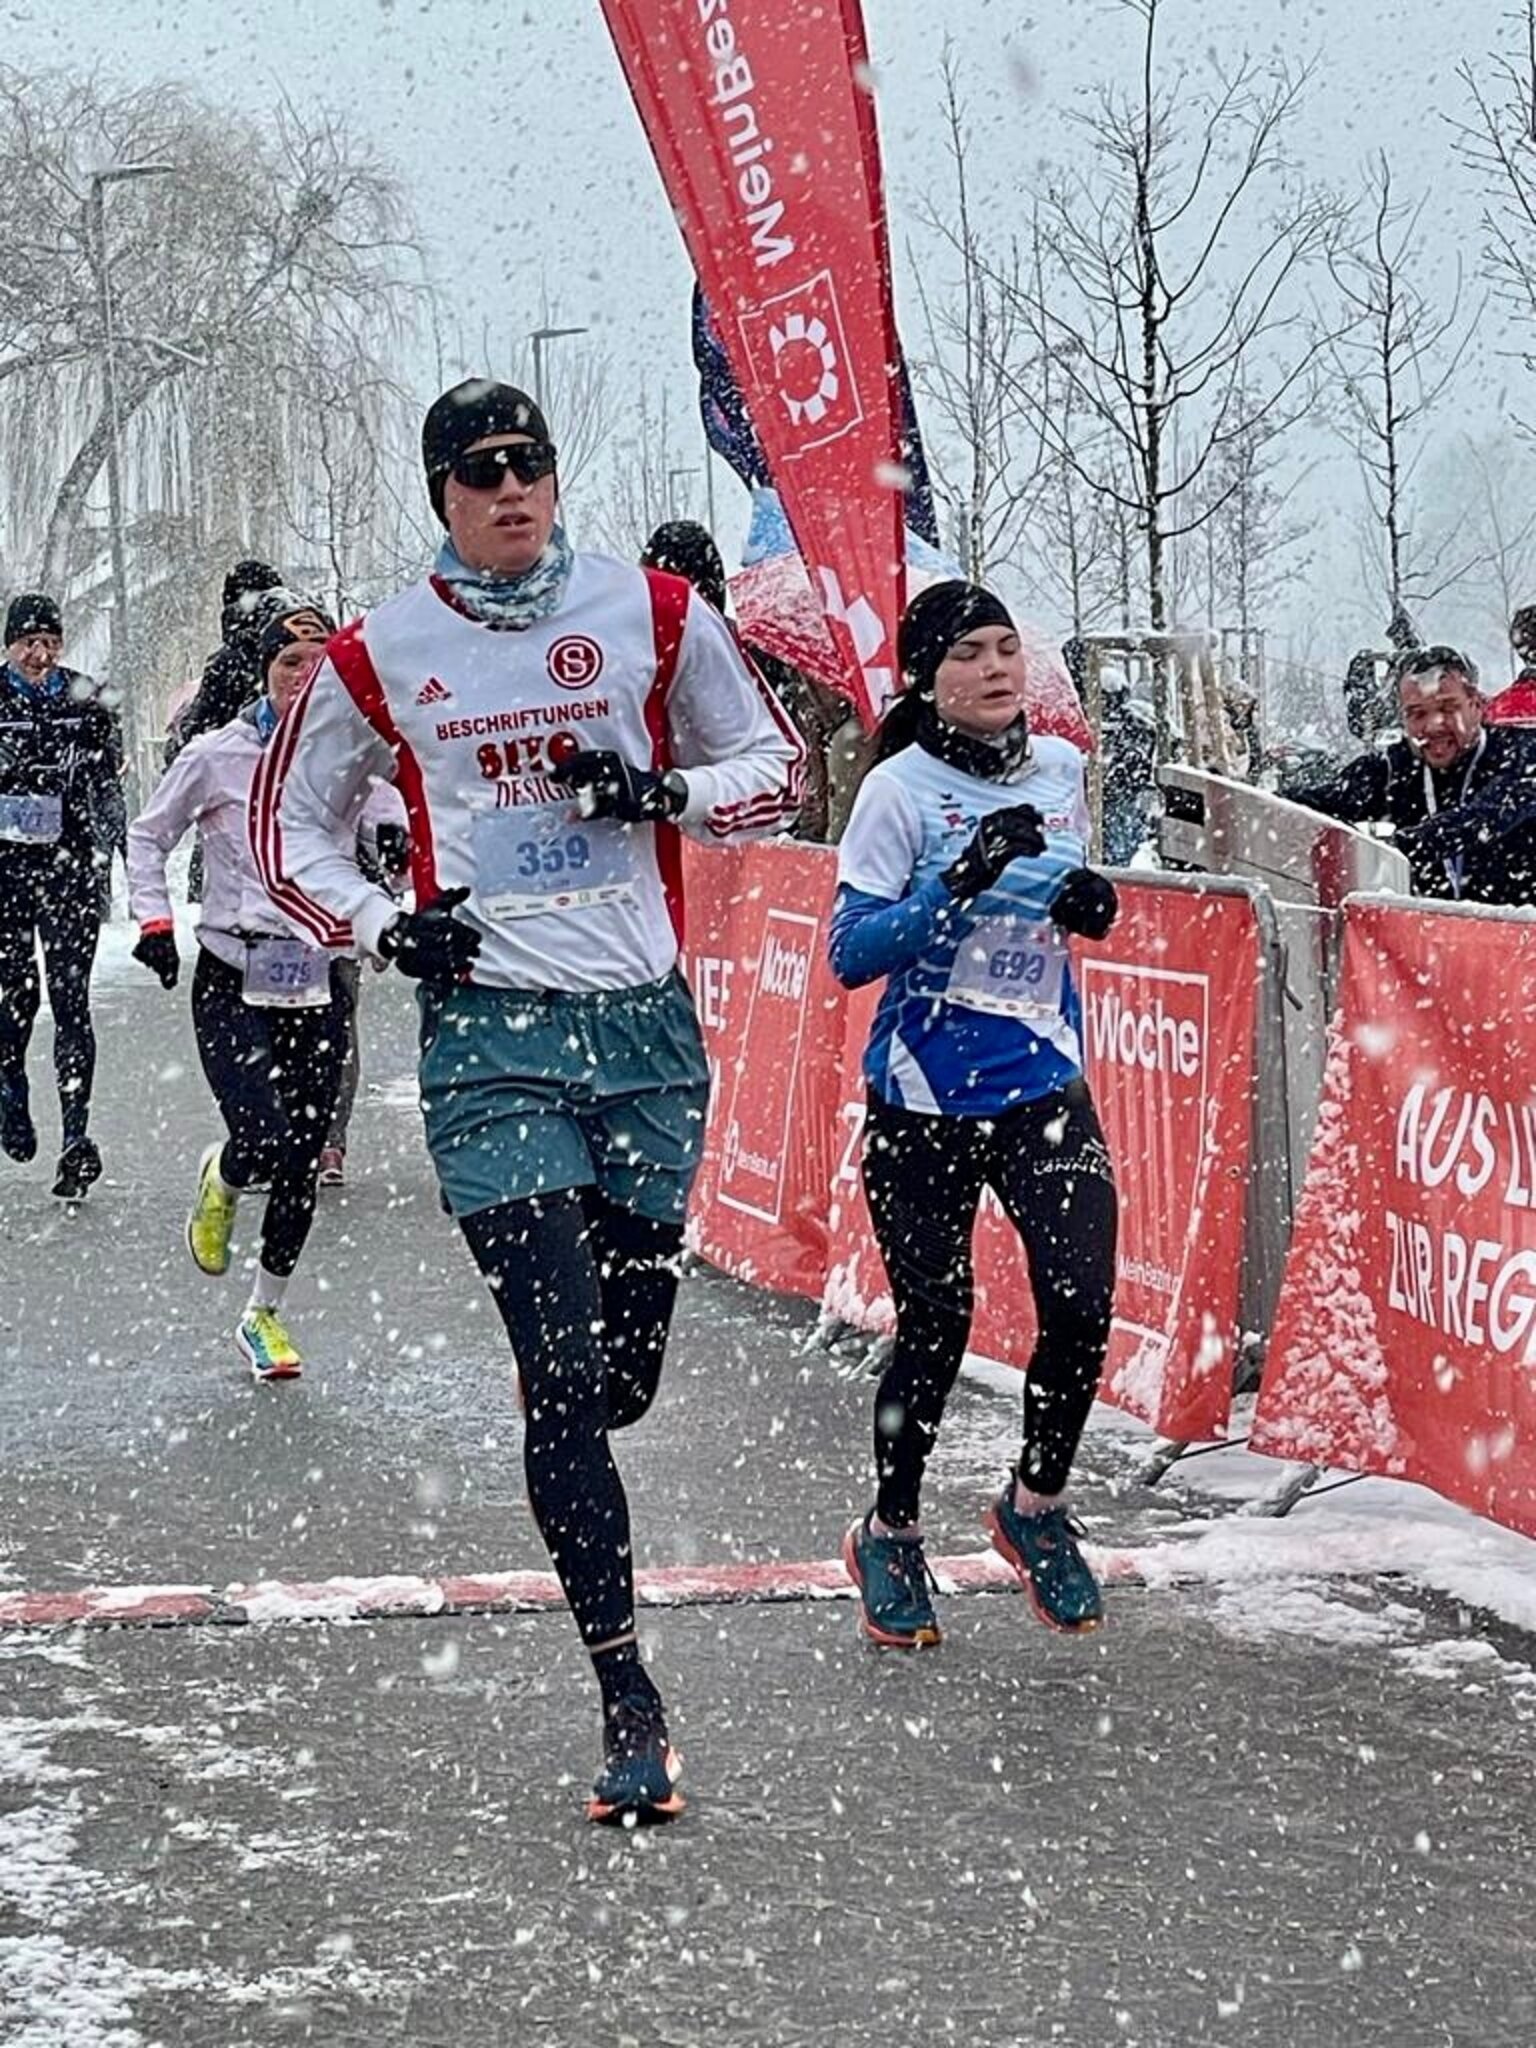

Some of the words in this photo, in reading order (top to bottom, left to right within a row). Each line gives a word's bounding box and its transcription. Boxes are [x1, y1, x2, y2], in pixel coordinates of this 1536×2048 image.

[561, 644, 589, 679] S
[436, 699, 609, 741] BESCHRIFTUNGEN
[516, 833, 589, 877] 359
[1088, 990, 1200, 1078] Woche
[1396, 1082, 1498, 1195] AUS
[1503, 1101, 1536, 1208] LI
[1386, 1210, 1437, 1328] ZUR
